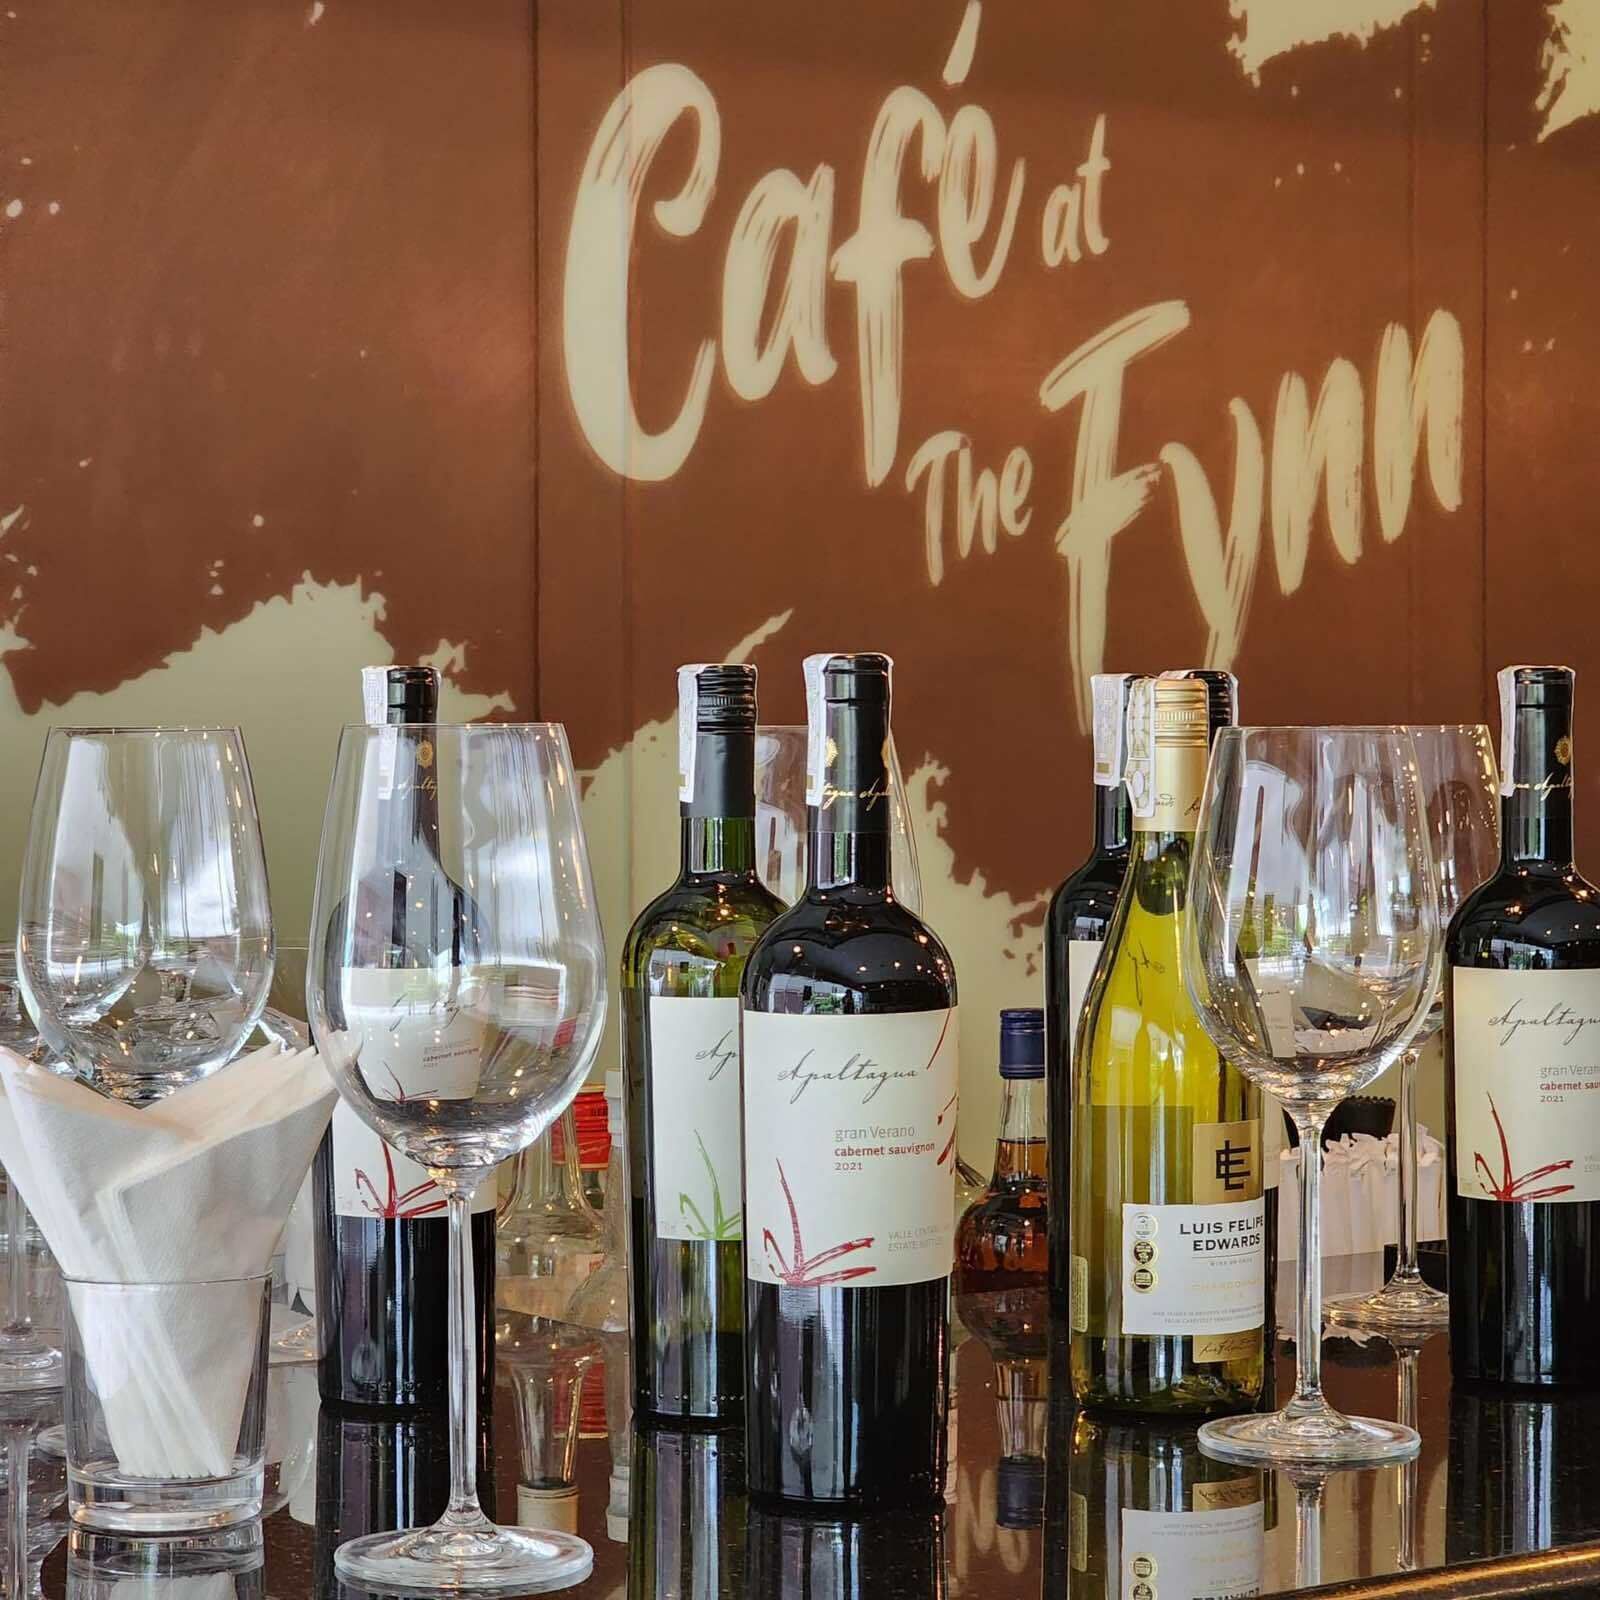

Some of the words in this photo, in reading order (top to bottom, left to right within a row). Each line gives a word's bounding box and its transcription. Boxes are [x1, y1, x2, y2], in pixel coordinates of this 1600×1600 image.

[563, 0, 1025, 487] Café
[1041, 113, 1112, 268] at
[906, 430, 1034, 586] The
[1039, 299, 1466, 736] Fynn
[776, 1048, 920, 1105] Apaltagua
[1540, 1066, 1568, 1079] gran
[1539, 1081, 1582, 1091] cabernet
[1540, 1095, 1564, 1103] 2021
[834, 1128, 867, 1143] gran
[868, 1125, 916, 1139] Verano
[834, 1145, 885, 1157] cabernet
[888, 1142, 936, 1155] sauvignon
[834, 1161, 864, 1171] 2021
[1180, 1221, 1223, 1235] LUIS
[1193, 1232, 1260, 1251] EDWARDS
